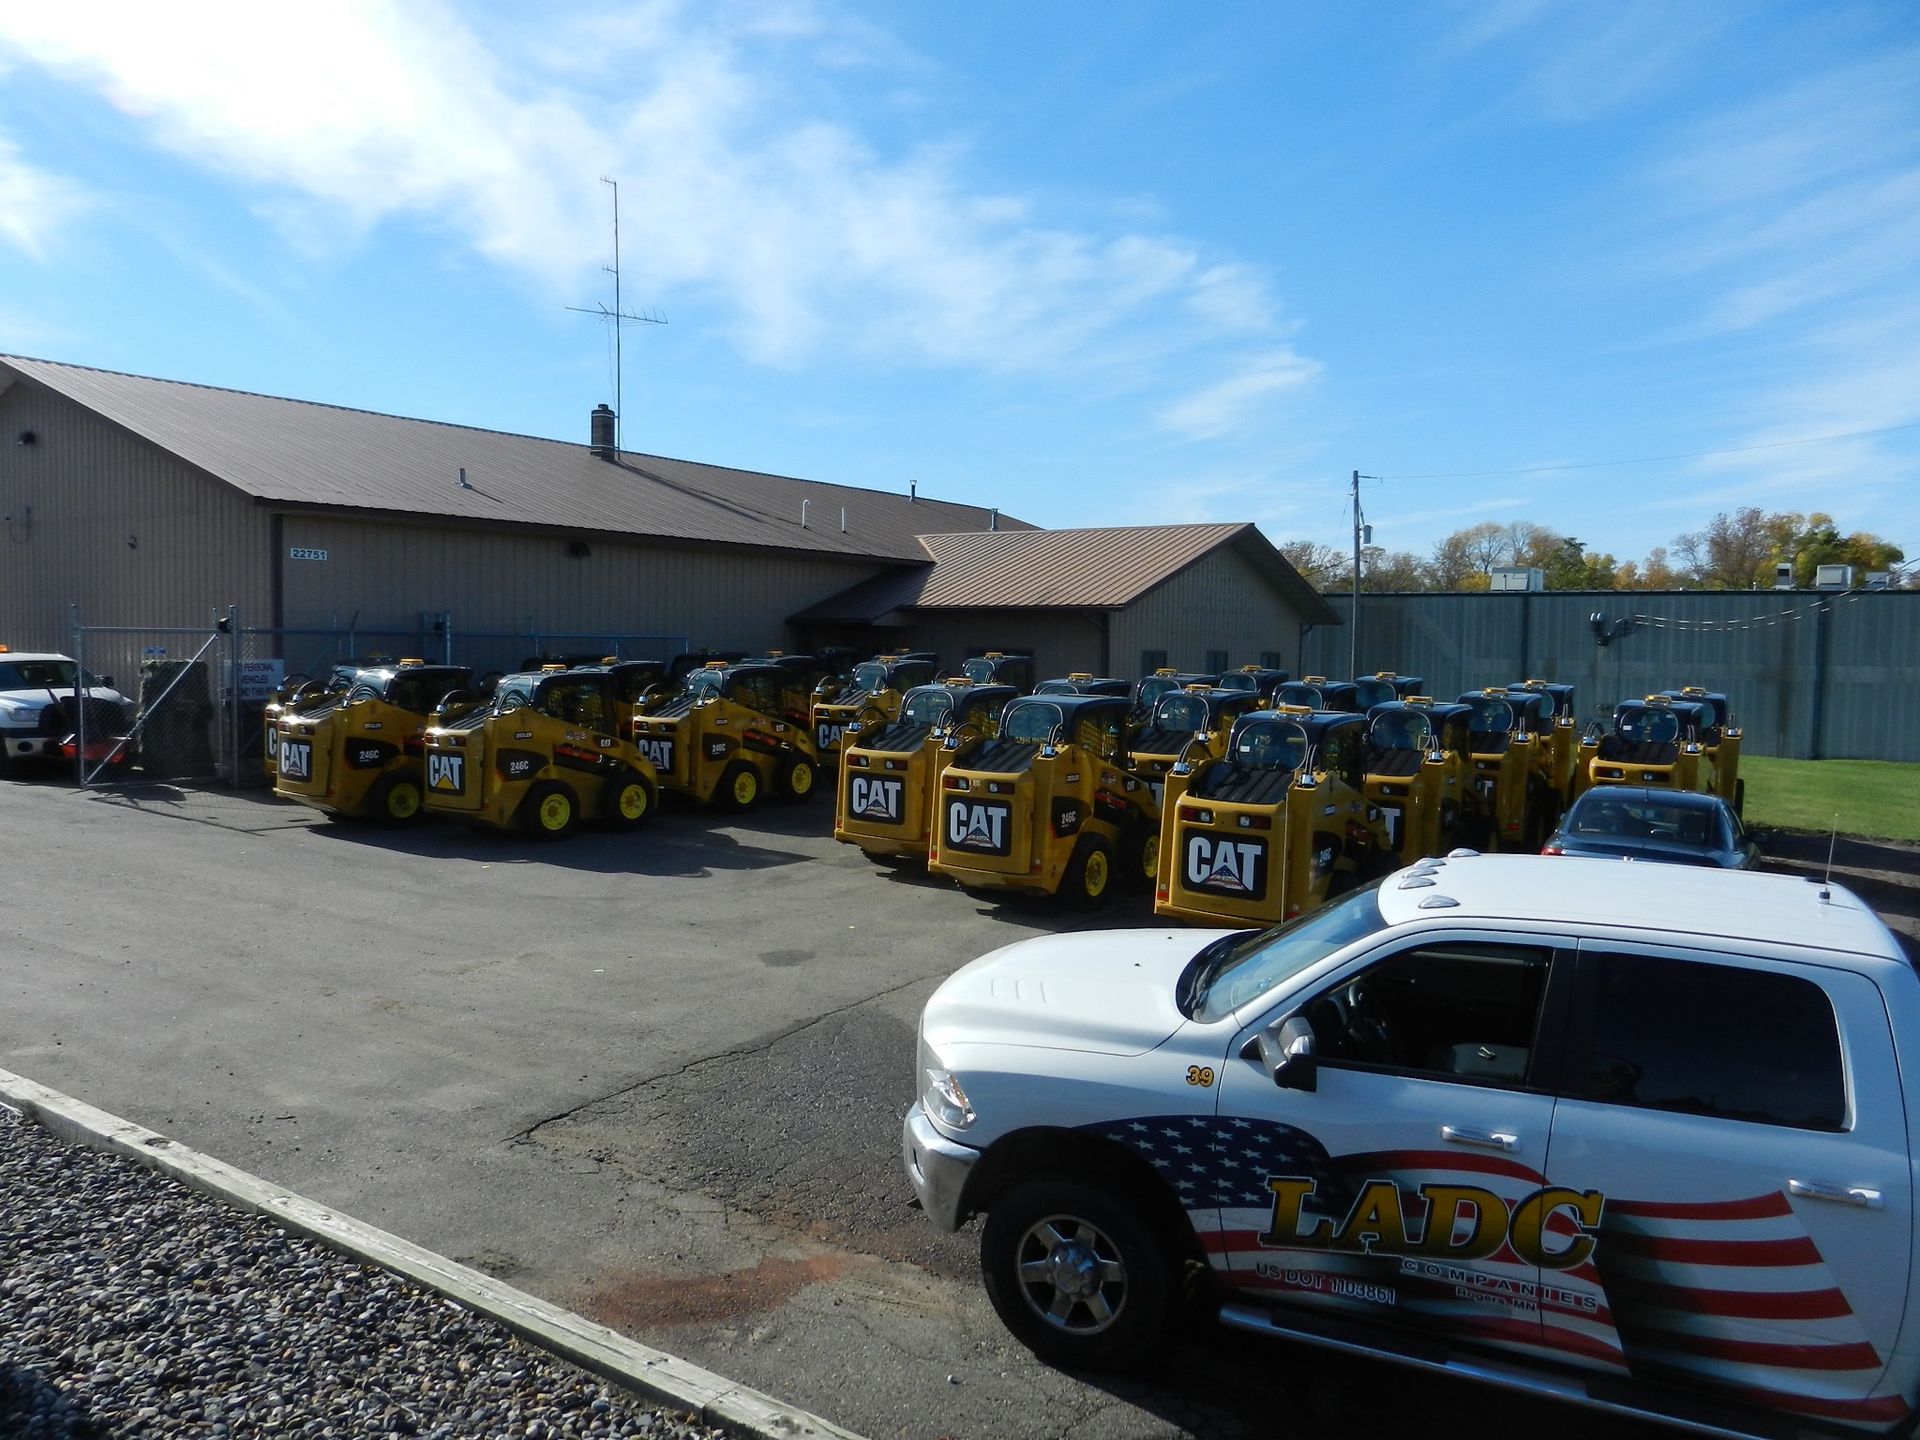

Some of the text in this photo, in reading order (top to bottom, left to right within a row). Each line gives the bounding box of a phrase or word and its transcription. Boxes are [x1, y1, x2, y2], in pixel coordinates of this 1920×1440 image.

[292, 549, 326, 560] 22751
[819, 724, 849, 749] CA
[281, 742, 311, 777] CAT
[429, 754, 463, 790] CAT
[510, 760, 529, 772] 246C
[852, 777, 902, 818] CAT
[950, 801, 1007, 849] CAT
[1188, 836, 1262, 891] CAT
[1185, 1064, 1215, 1088] 39
[1256, 1175, 1605, 1272] LADC
[1256, 1261, 1396, 1305] US DOT 1103861
[1402, 1259, 1599, 1312] COMPANIES
[1512, 1297, 1537, 1312] MN
